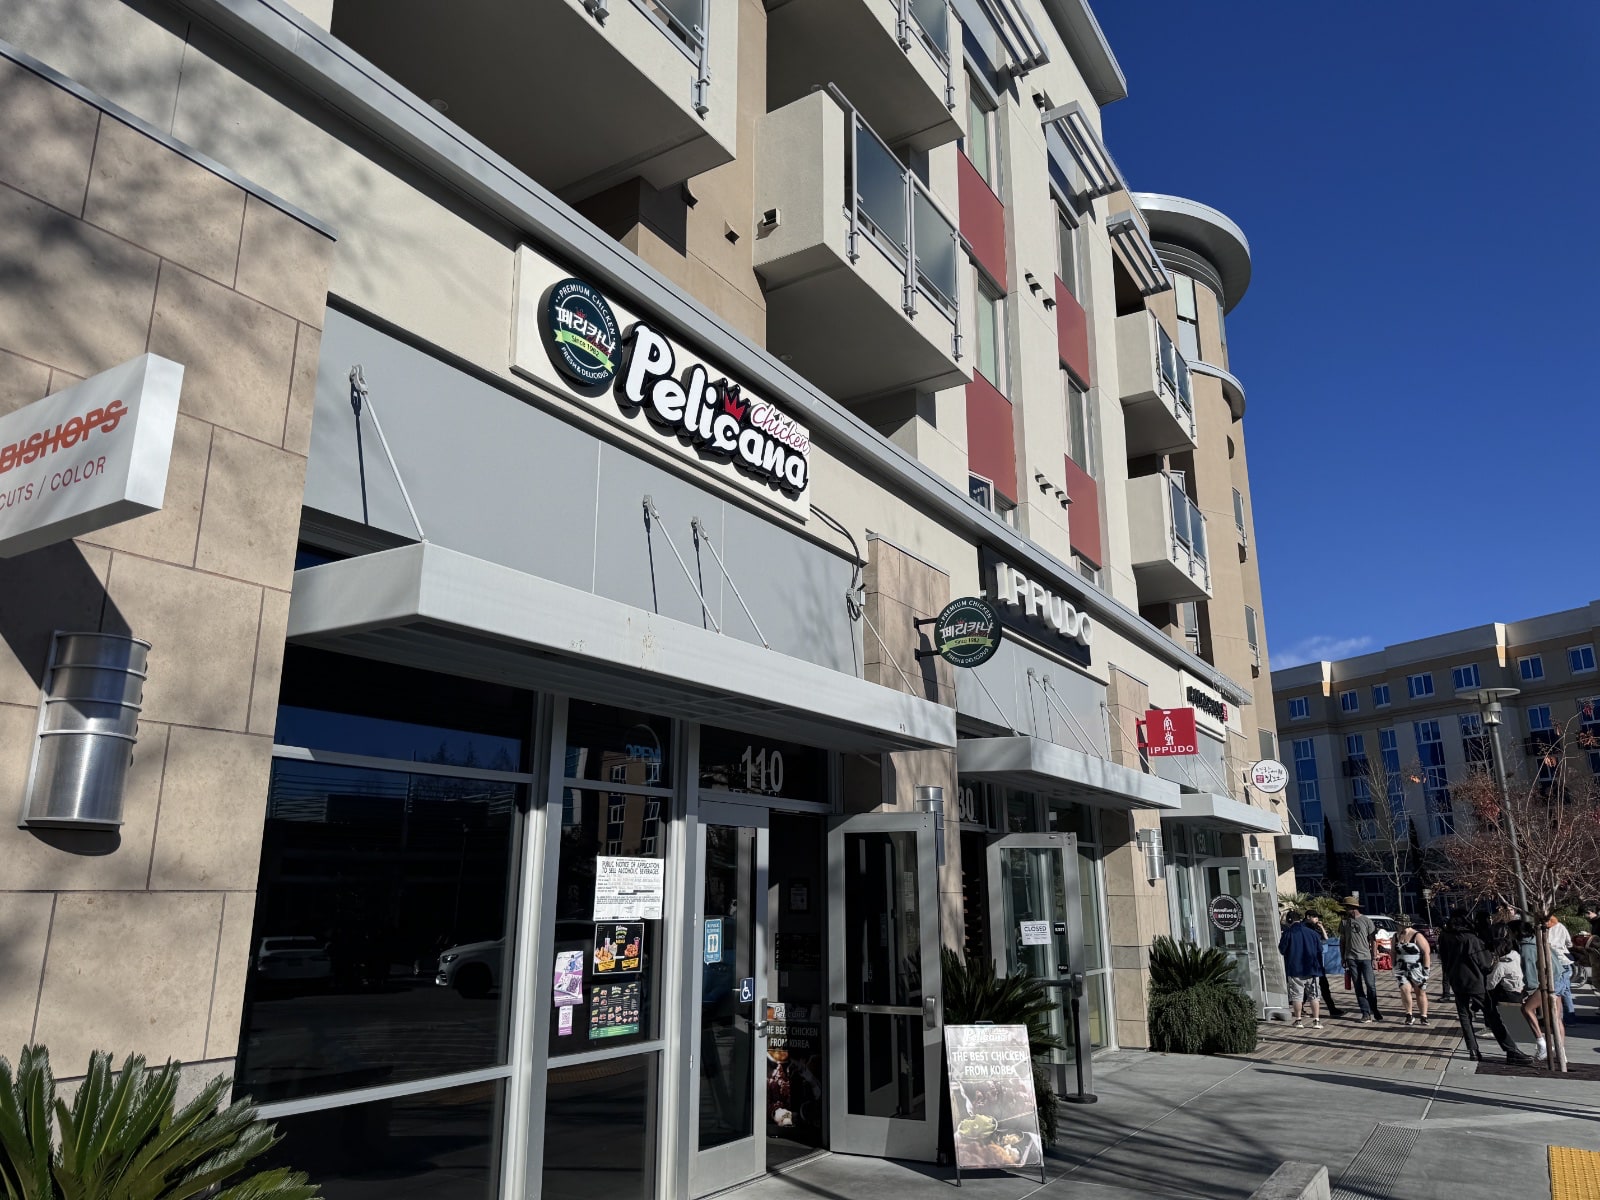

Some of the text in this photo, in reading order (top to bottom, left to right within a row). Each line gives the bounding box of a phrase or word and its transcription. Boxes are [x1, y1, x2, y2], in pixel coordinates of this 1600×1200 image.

[559, 284, 616, 336] PREMIUM CHICKEN
[625, 324, 806, 489] Pelicana
[751, 404, 811, 453] Chicken
[0, 399, 128, 474] BISHOPS
[51, 456, 106, 492] COLOR
[941, 600, 993, 621] PREMIUM CHICKEN
[996, 561, 1094, 646] IPPUDO
[741, 745, 784, 793] 110
[1150, 745, 1194, 755] IPPUDO
[952, 1050, 1025, 1062] THE BEST CHICKEN
[964, 1065, 1015, 1076] FROM KOREA
